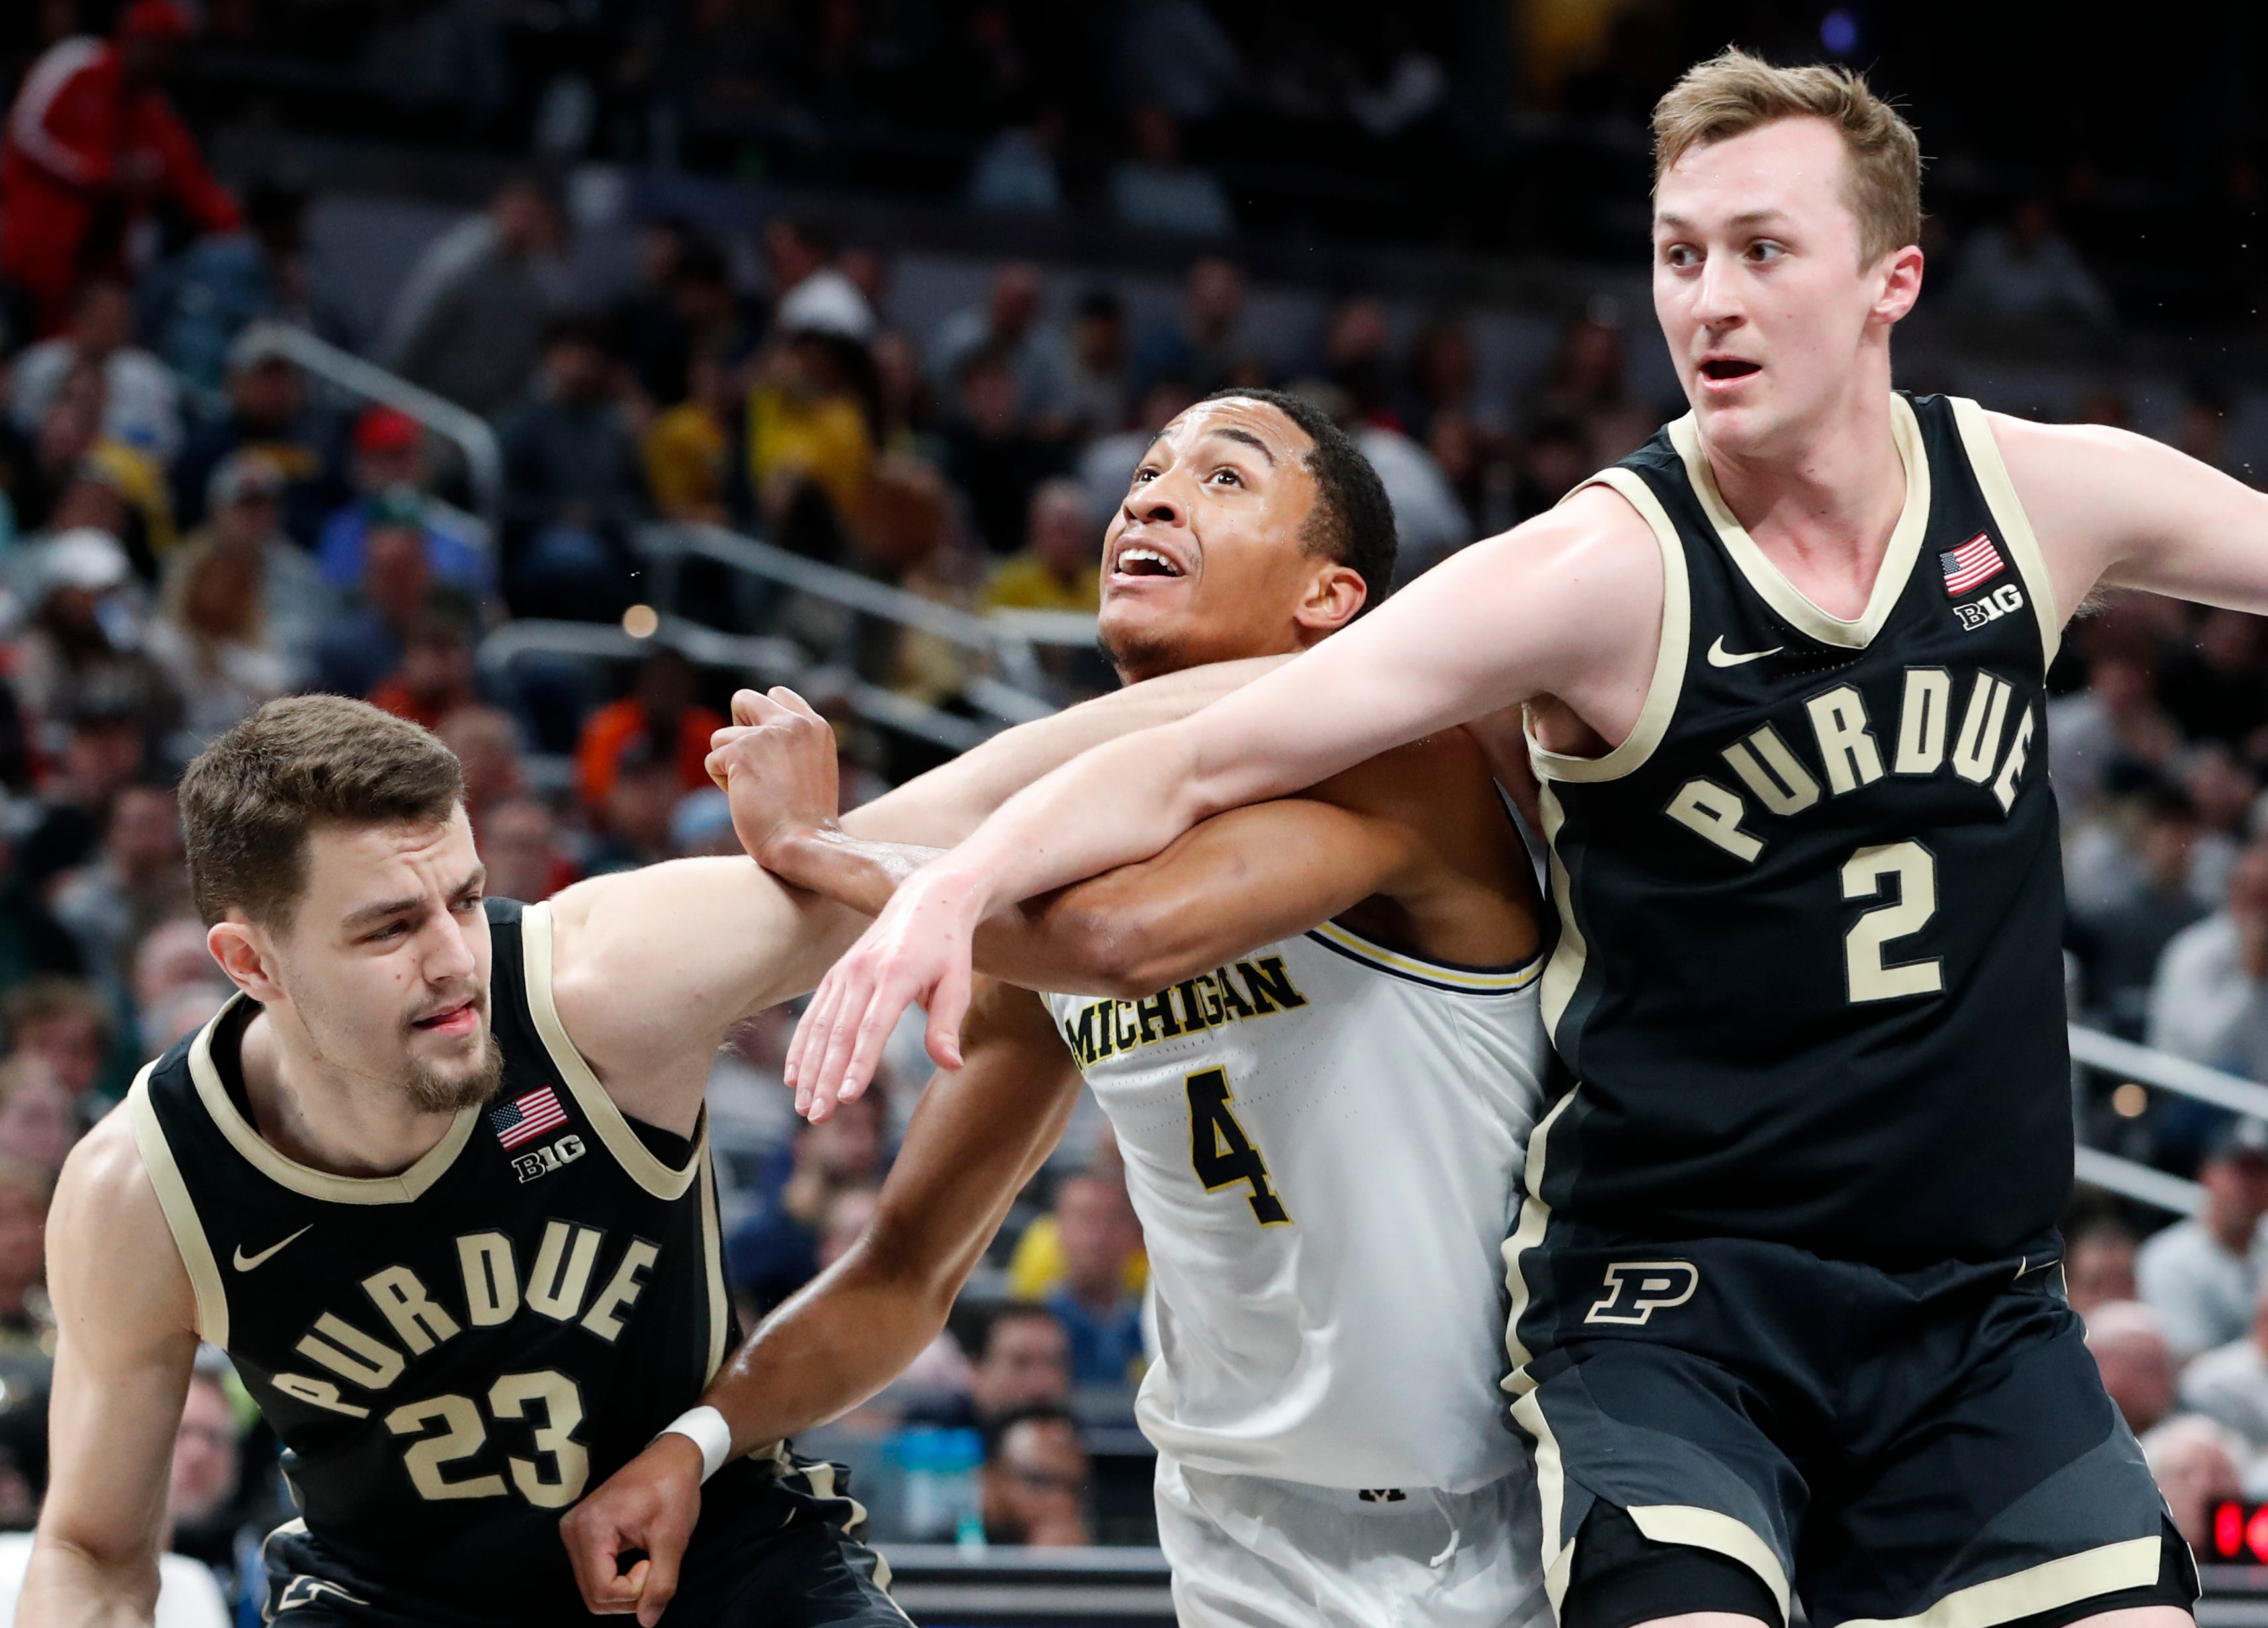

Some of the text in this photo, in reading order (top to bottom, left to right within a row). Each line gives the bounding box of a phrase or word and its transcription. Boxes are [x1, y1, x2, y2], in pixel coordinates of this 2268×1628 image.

[1659, 664, 2034, 866] PURDUE
[1838, 836, 1946, 1006] 2
[1064, 954, 1310, 1074] MICHIGAN
[1184, 1064, 1295, 1228] 4
[268, 1216, 662, 1420] PURDUE
[1583, 1261, 1699, 1326] P
[382, 1365, 591, 1510] 23
